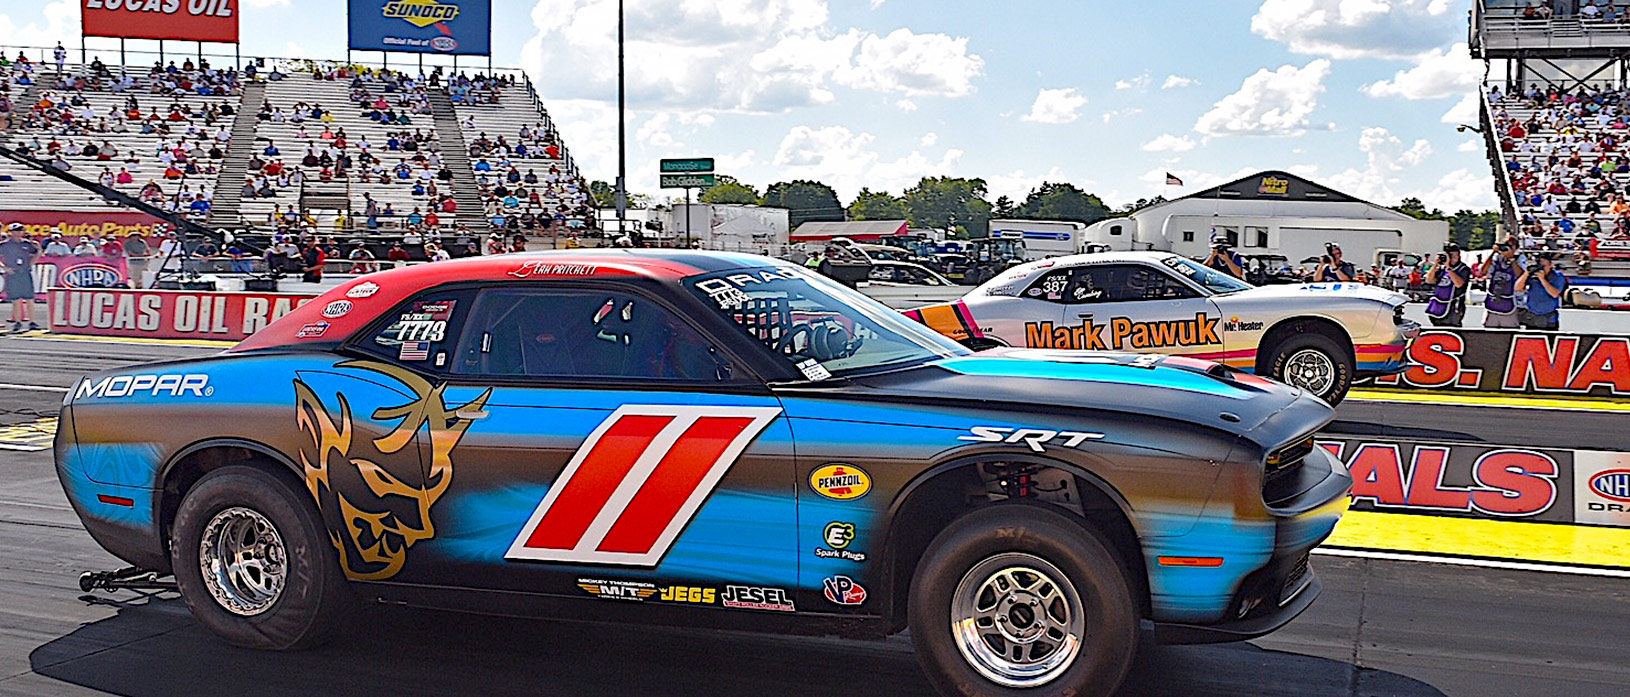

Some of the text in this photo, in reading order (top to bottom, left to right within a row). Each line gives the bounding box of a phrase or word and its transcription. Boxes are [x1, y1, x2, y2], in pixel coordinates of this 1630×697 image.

[86, 0, 233, 17] LUCAS OIL
[386, 3, 455, 19] SUNOCO
[1262, 176, 1288, 186] Nitro
[57, 222, 99, 236] Auto
[101, 222, 150, 236] Parts
[551, 264, 598, 275] PRITCHETT
[1043, 281, 1068, 293] 387
[53, 291, 313, 334] LUCAS OIL RA
[1025, 312, 1221, 350] Mark Pawuk
[1224, 322, 1264, 331] Mr. Heater
[1273, 352, 1287, 377] EAGLE
[76, 374, 208, 399] MOPAR
[957, 426, 1105, 452] SRT
[818, 474, 864, 489] PENNZOIL
[816, 548, 865, 561] Spark Plugs
[600, 585, 639, 596] M/T
[661, 586, 716, 603] JEGS
[721, 585, 793, 606] JESEL
